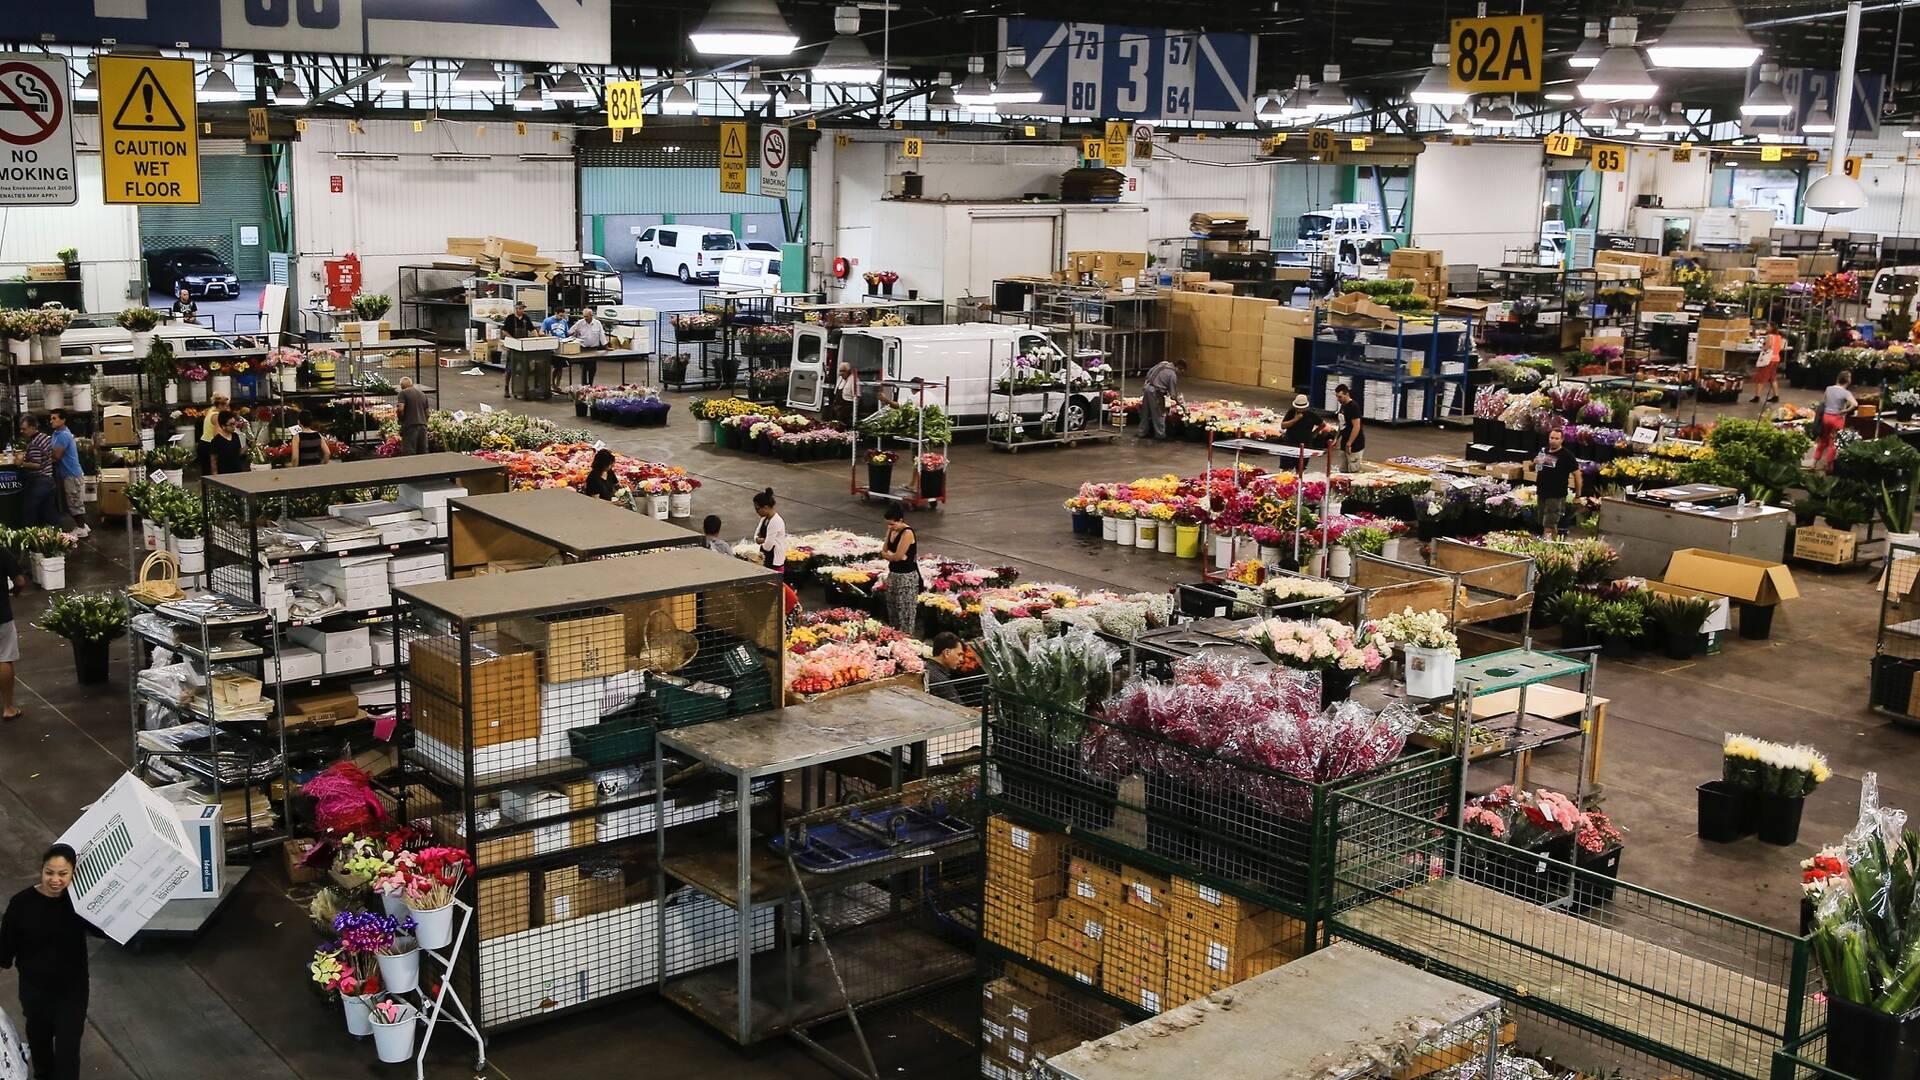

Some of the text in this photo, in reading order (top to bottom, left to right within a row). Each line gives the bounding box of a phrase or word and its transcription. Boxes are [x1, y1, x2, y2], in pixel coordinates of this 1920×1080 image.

[1074, 30, 1099, 60] 73
[1168, 37, 1193, 65] 57
[1457, 26, 1531, 82] 82A
[1116, 33, 1150, 113] 3
[1071, 82, 1097, 110] 80
[1166, 86, 1190, 114] 64
[611, 88, 640, 121] 83A
[250, 113, 267, 136] 84A
[114, 140, 187, 156] CAUTION
[907, 141, 918, 155] 88
[1313, 132, 1329, 150] 86
[1553, 136, 1569, 151] 70
[11, 150, 38, 163] NO
[1088, 143, 1100, 158] 87
[1138, 144, 1149, 156] 72
[723, 162, 743, 170] CAUTION
[1598, 150, 1619, 170] 85
[1844, 159, 1854, 176] 9
[0, 167, 69, 181] MOKING
[134, 161, 170, 176] WET
[728, 172, 738, 180] WET
[125, 181, 181, 197] FLOOR
[725, 182, 741, 190] FLOOR
[762, 177, 786, 187] SMOKING
[0, 481, 23, 489] WERS
